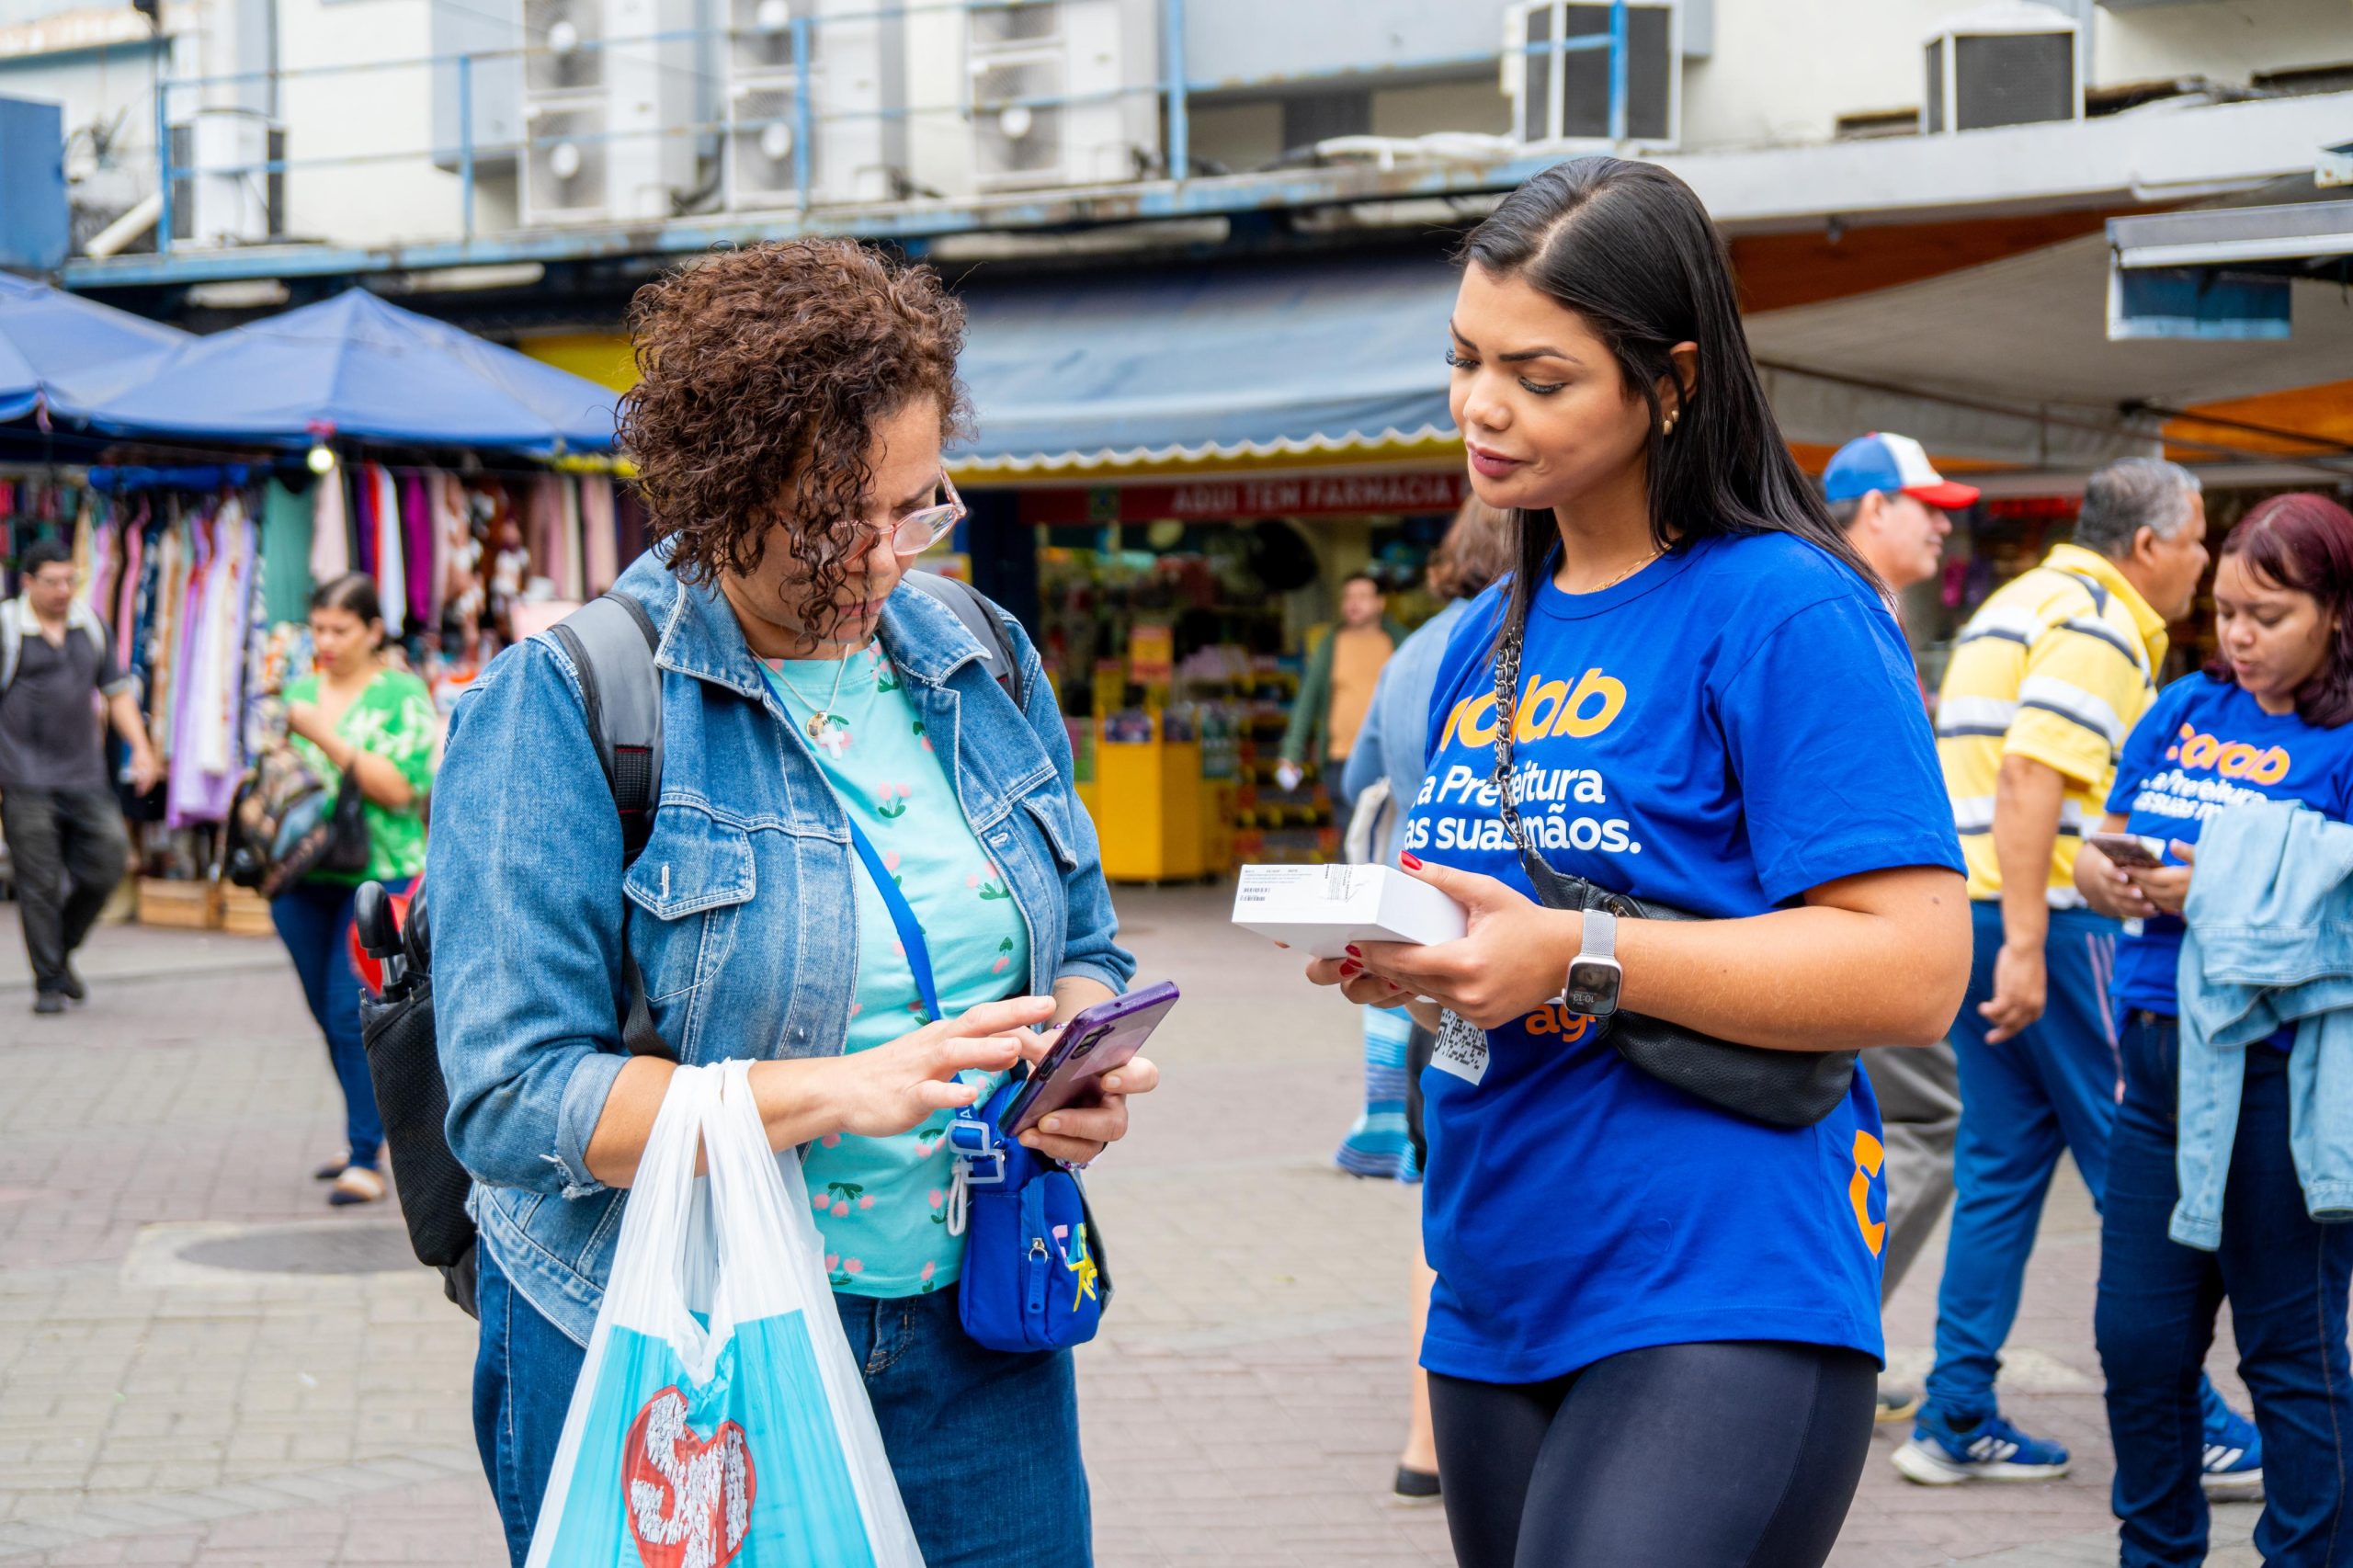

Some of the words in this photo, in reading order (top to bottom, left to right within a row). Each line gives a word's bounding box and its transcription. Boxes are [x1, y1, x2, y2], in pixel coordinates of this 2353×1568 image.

[1175, 483, 1237, 511] AQUI
[1245, 480, 1301, 508] TEM
[1522, 803, 1642, 855] mãos.
[1573, 994, 1595, 1004] 10:13
